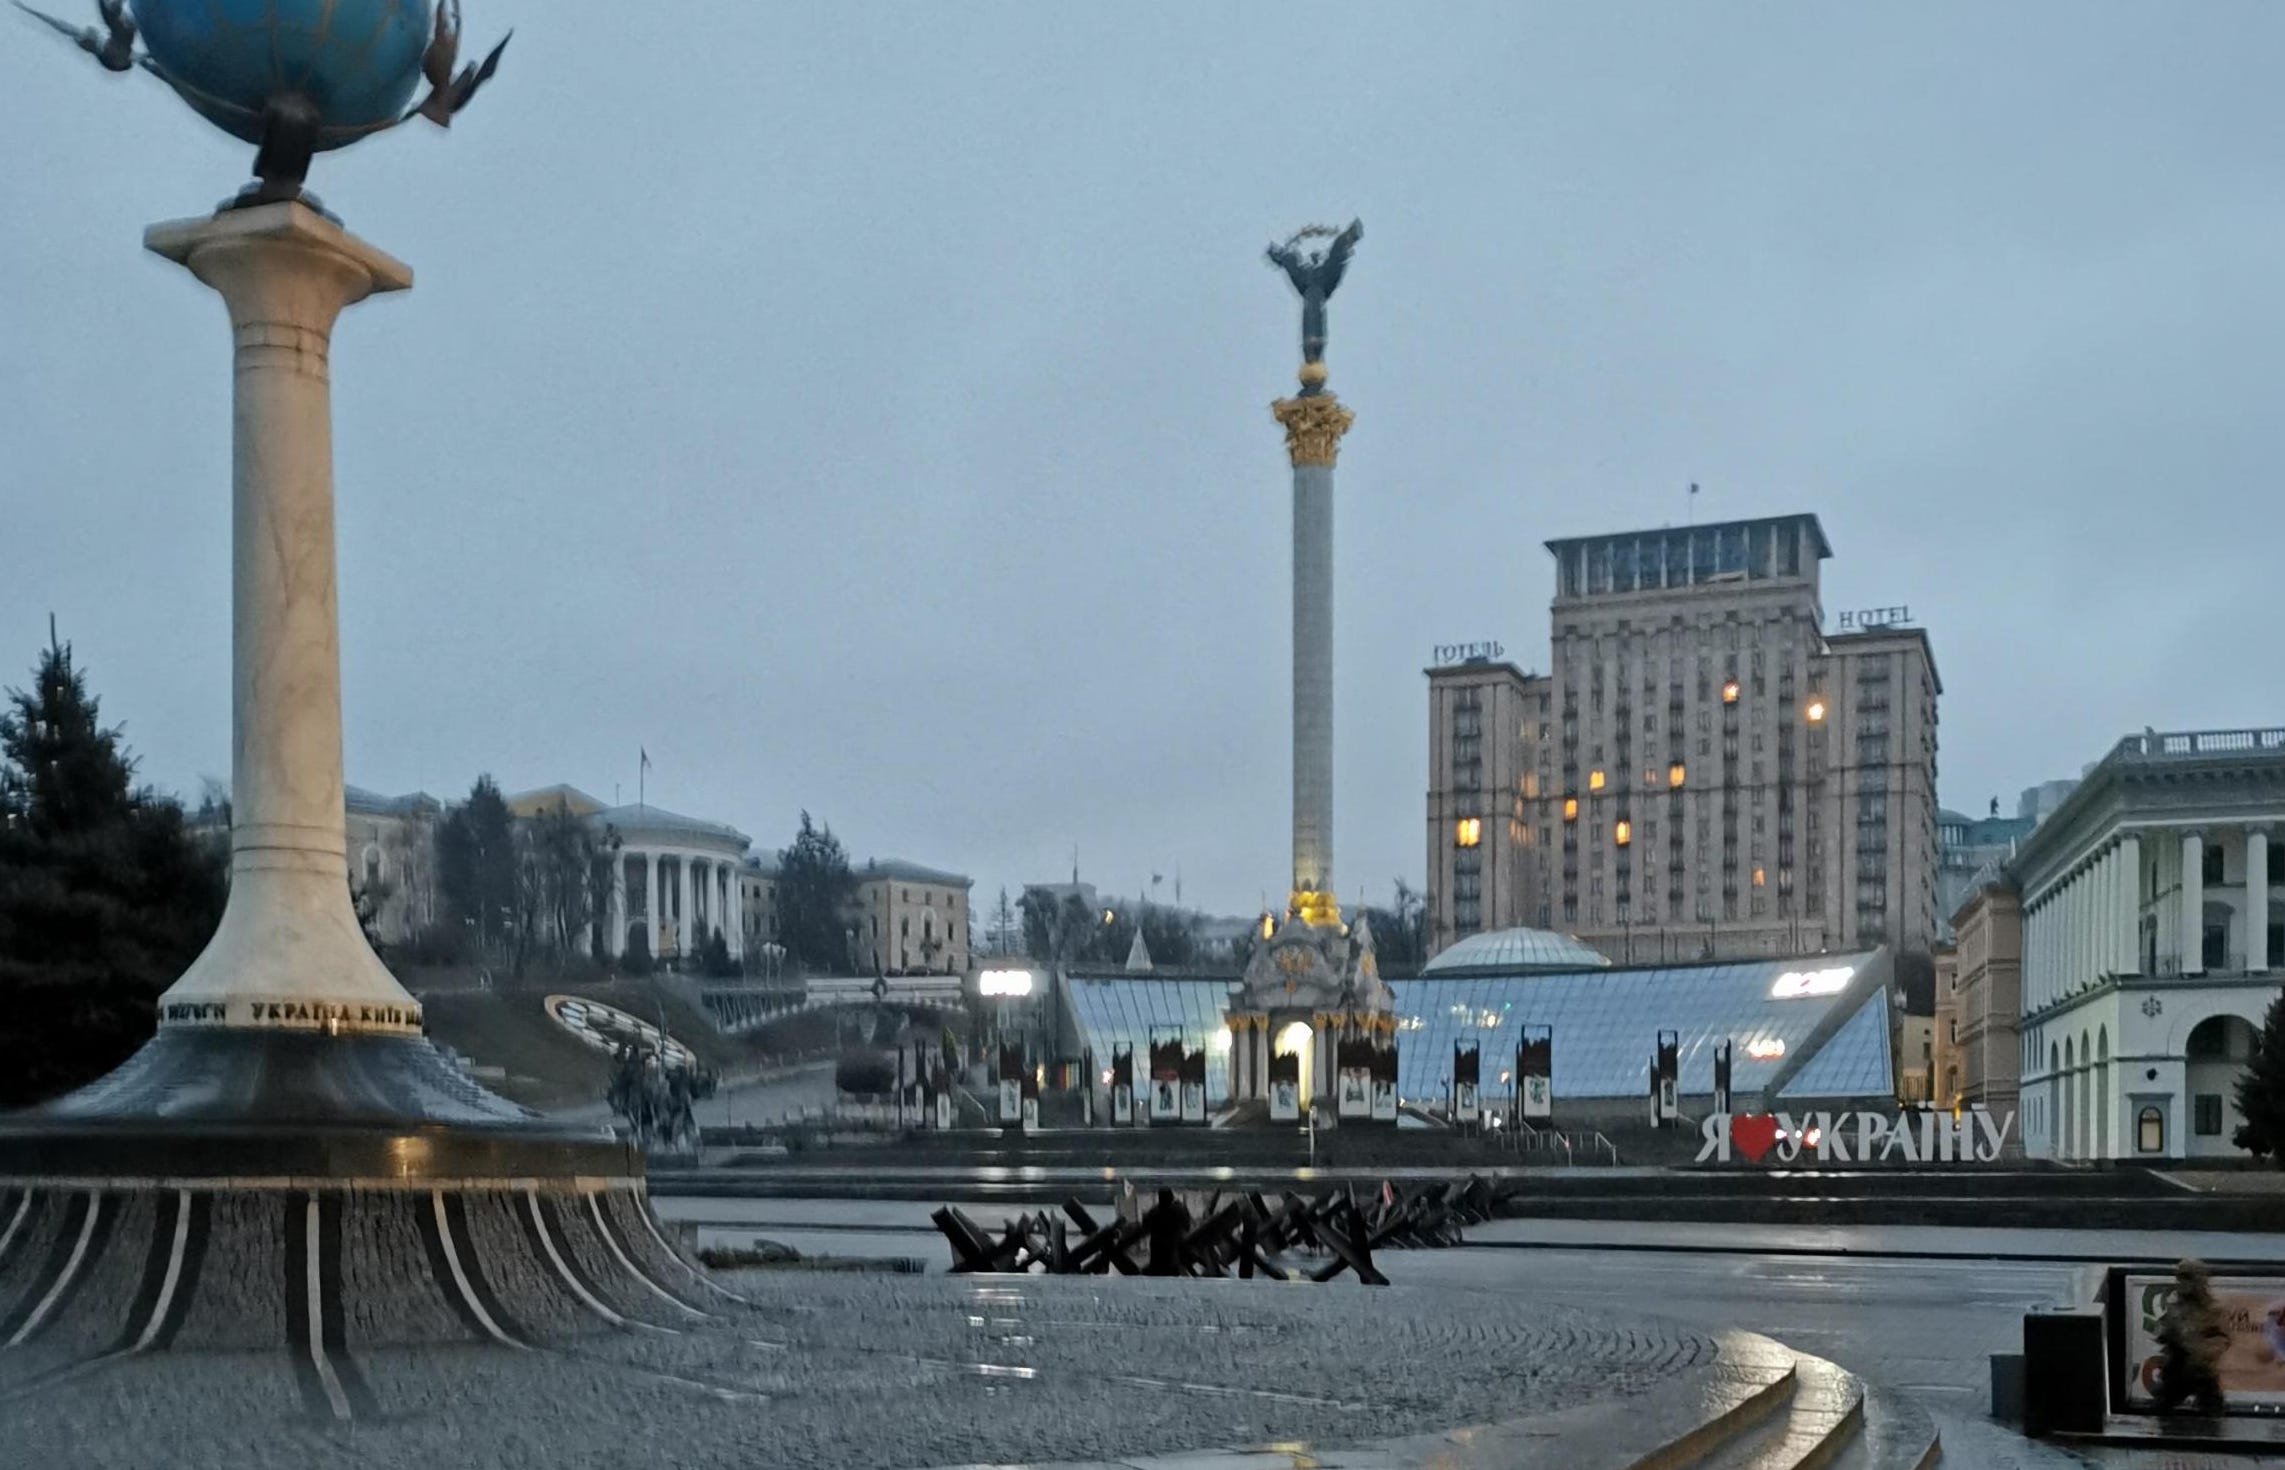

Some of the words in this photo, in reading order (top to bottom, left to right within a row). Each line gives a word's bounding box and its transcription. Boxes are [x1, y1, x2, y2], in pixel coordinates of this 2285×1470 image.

[1839, 605, 1914, 629] HOTEL
[1694, 1111, 1732, 1162] Я
[1775, 1101, 2015, 1162] УКРАЇНУ
